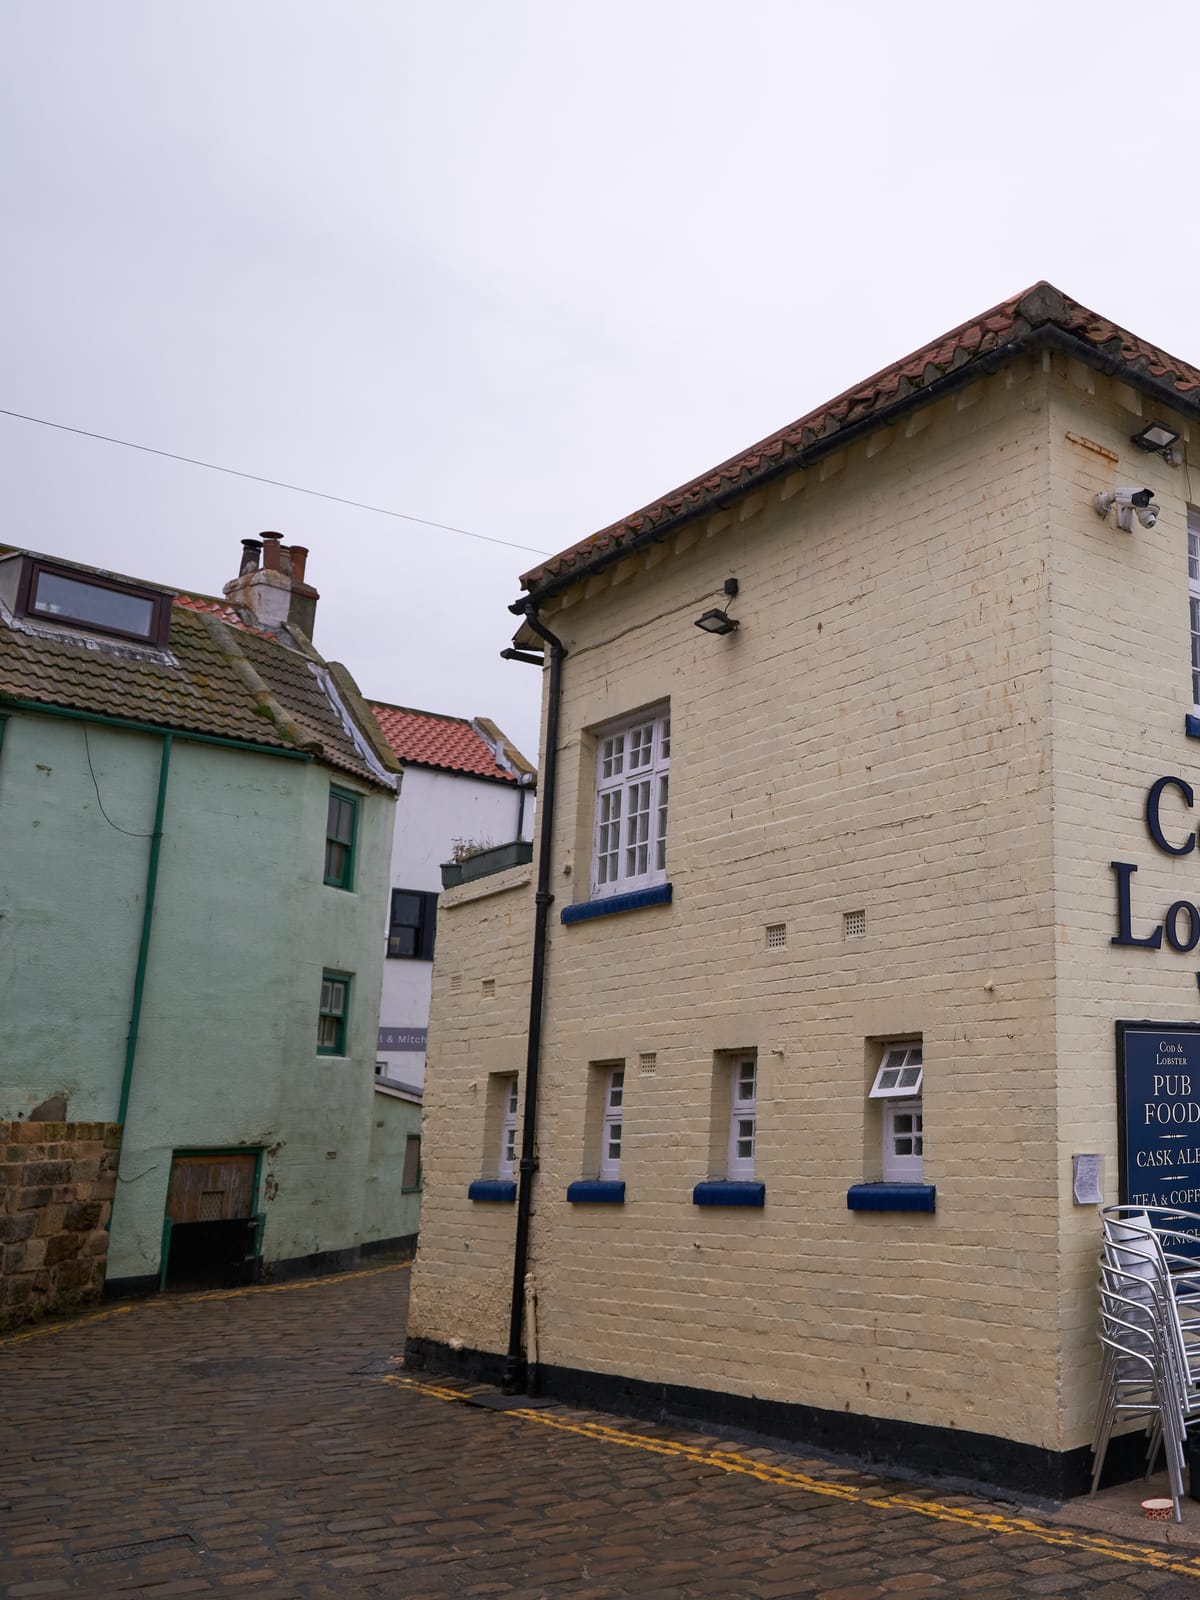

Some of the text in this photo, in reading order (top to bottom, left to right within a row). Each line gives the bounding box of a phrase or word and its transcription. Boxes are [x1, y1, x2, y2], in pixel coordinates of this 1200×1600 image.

[1177, 1043, 1184, 1053] &
[1156, 1053, 1188, 1066] LOBSTER
[1153, 1074, 1192, 1096] PUB
[1144, 1102, 1200, 1125] FOOD
[1136, 1149, 1174, 1168] CASK
[1132, 1193, 1158, 1207] TEA
[1161, 1194, 1168, 1206] &
